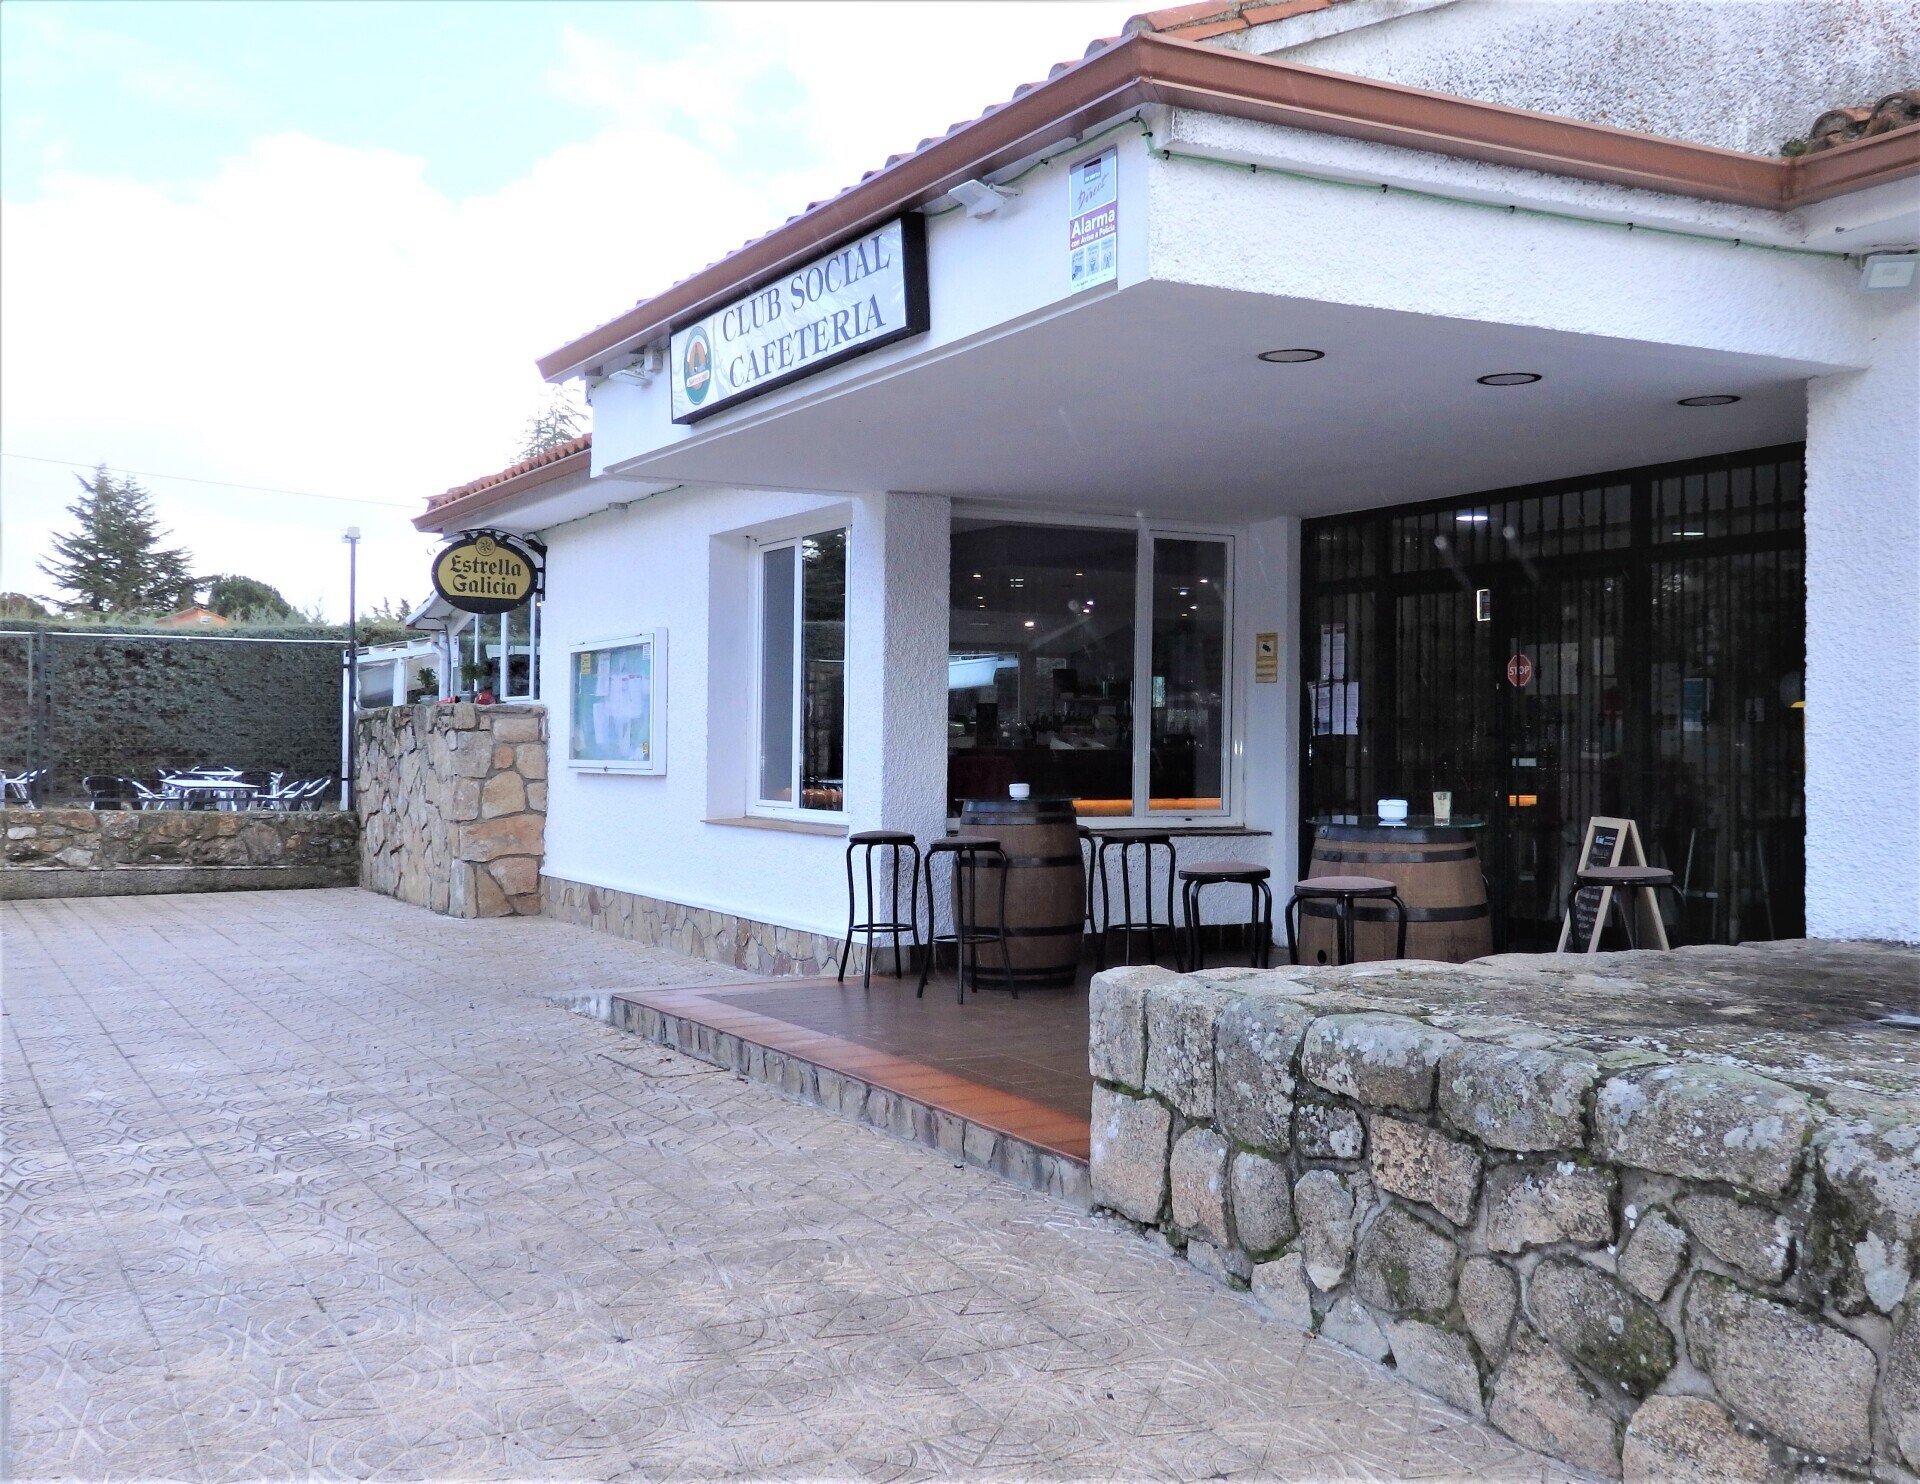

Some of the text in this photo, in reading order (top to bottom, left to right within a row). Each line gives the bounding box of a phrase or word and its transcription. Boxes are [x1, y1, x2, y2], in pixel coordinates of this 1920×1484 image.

[1071, 209, 1115, 239] Alarma
[722, 234, 891, 342] CLUB SOCIAL
[729, 294, 887, 388] CAFETERIA
[450, 555, 521, 577] Estrella
[453, 573, 517, 595] Galicia
